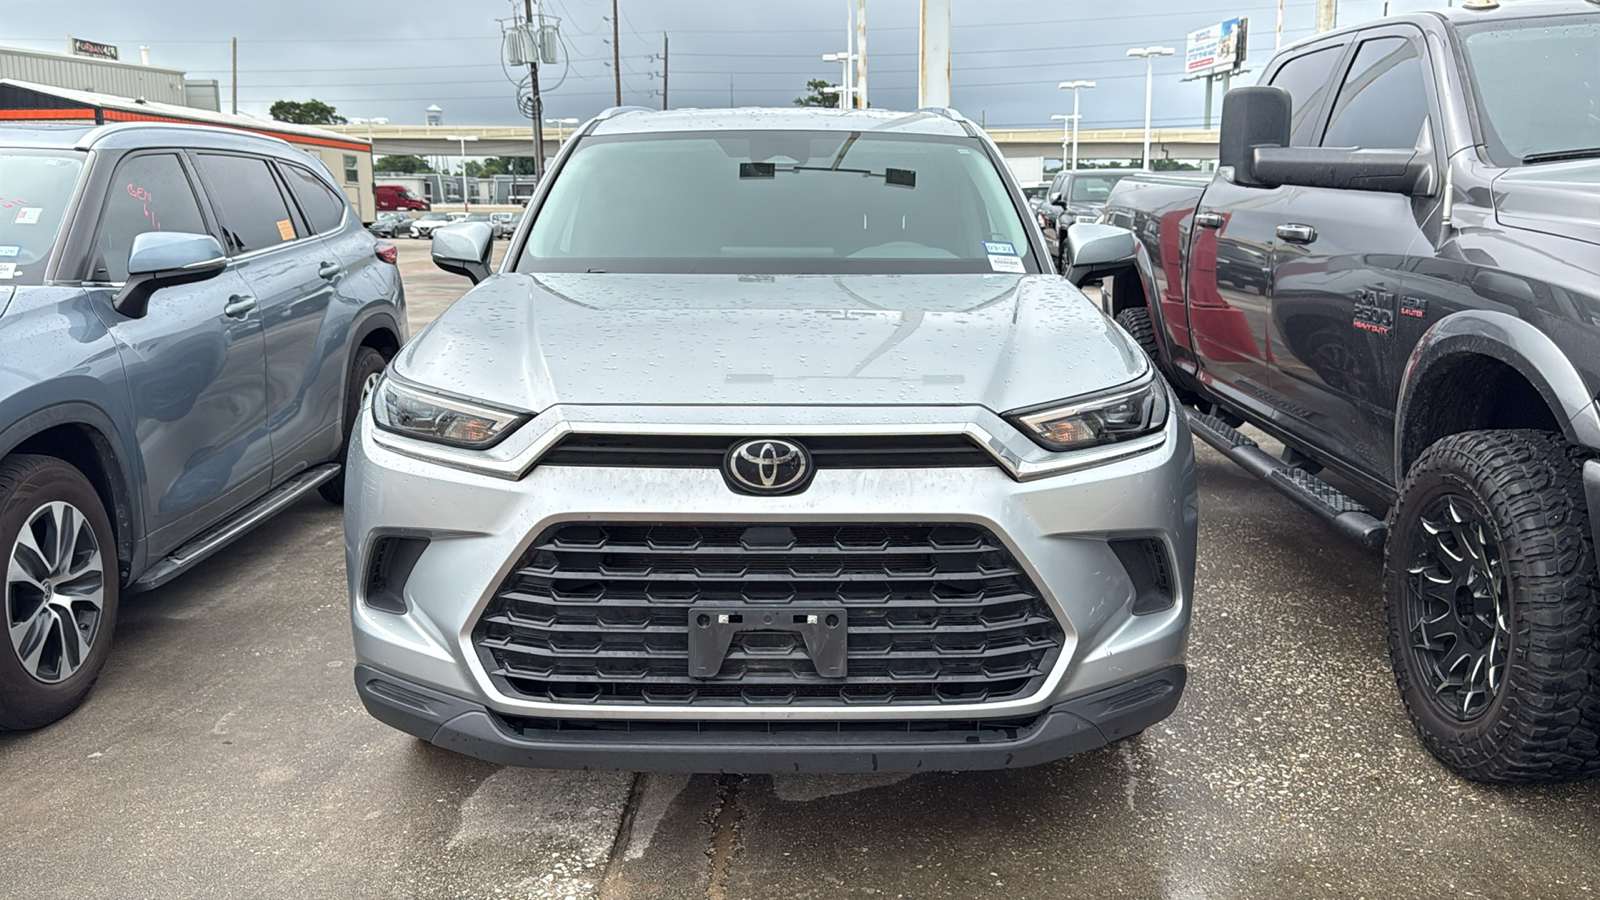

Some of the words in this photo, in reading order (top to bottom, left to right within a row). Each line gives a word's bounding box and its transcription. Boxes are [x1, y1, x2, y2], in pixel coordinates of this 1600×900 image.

[126, 183, 152, 203] GEN
[1355, 288, 1395, 309] RAM
[1401, 296, 1428, 309] HEMI
[1354, 303, 1392, 326] 2500
[1409, 309, 1423, 317] LITER
[1353, 320, 1371, 329] HEAVY
[1372, 325, 1389, 334] DUTY
